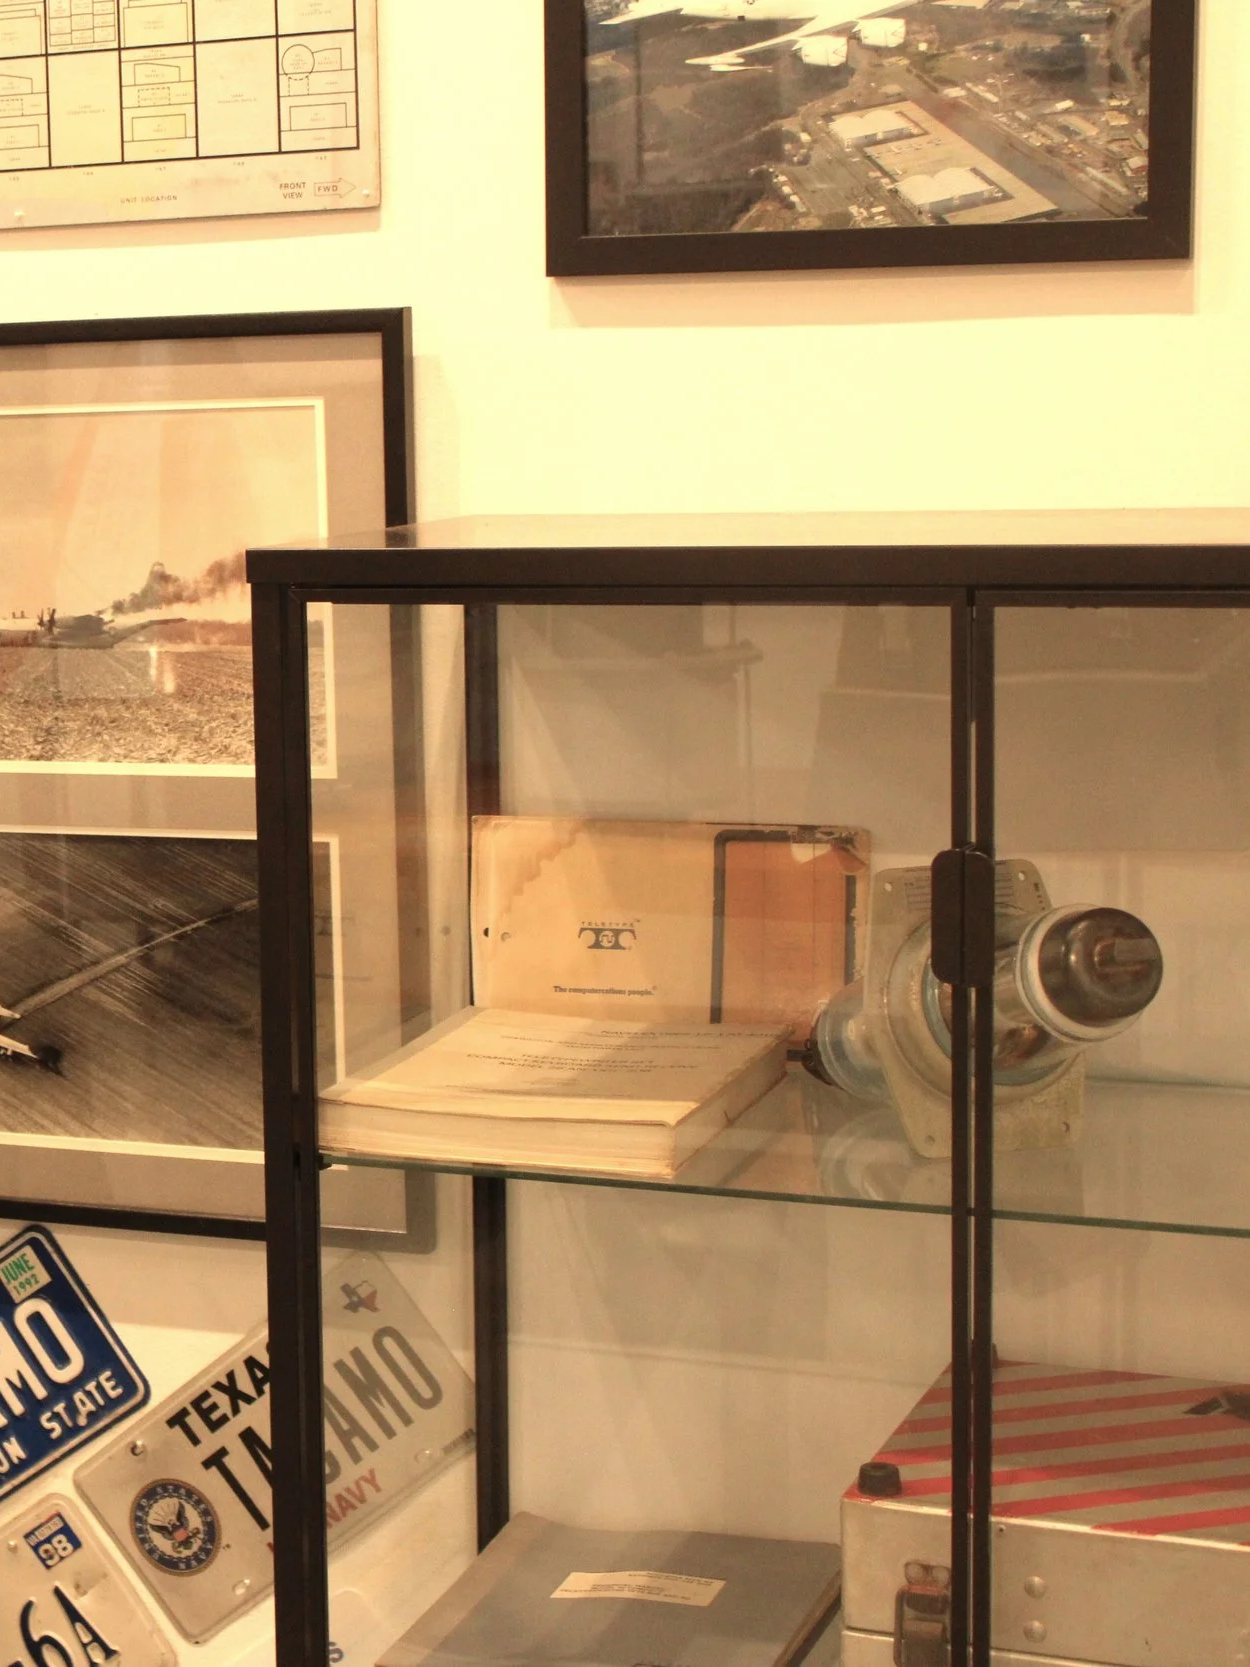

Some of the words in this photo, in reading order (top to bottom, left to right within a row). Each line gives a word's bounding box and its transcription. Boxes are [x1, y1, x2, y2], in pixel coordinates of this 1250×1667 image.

[279, 182, 307, 191] FRONT
[282, 191, 304, 200] VIEW
[317, 184, 339, 193] FWD
[553, 985, 567, 993] The
[1, 1254, 35, 1285] JUNE
[12, 1274, 40, 1296] 1992
[40, 1371, 124, 1440] STATE
[165, 1343, 271, 1447] TEXA
[201, 1326, 444, 1532] TAAMO
[38, 1533, 75, 1567] 98
